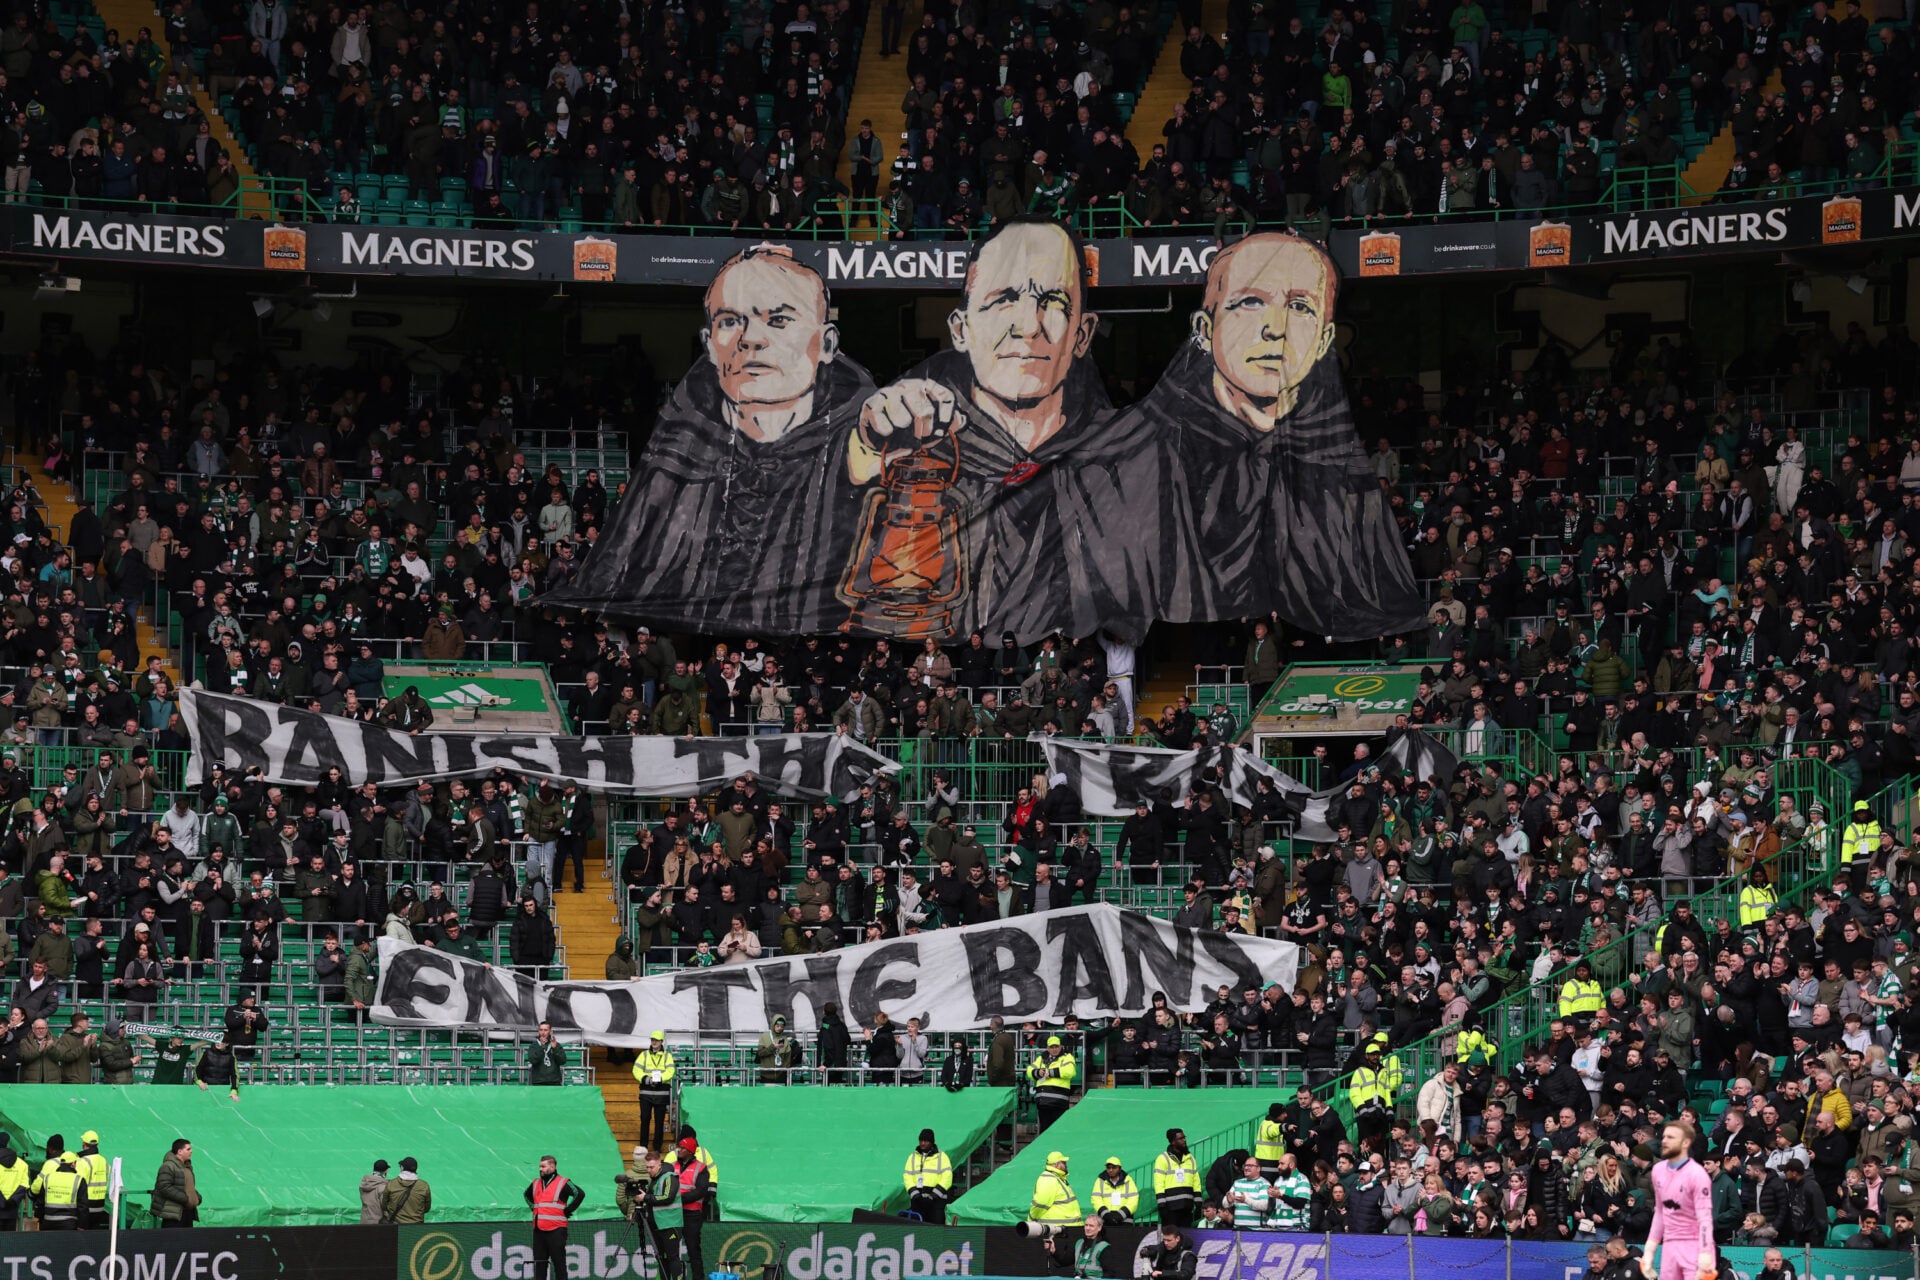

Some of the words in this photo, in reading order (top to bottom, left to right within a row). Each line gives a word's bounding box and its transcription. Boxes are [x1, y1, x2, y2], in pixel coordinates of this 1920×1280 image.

[33, 214, 225, 257] MAGNERS
[1604, 208, 1787, 254] MAGNERS
[1828, 221, 1855, 229] MAGNERS
[341, 232, 535, 271] MAGNERS
[827, 247, 966, 280] MAGNE
[1280, 698, 1408, 713] dafbet
[195, 690, 633, 795] BANISH
[673, 942, 930, 1039] THE
[787, 1231, 974, 1279] dafabet
